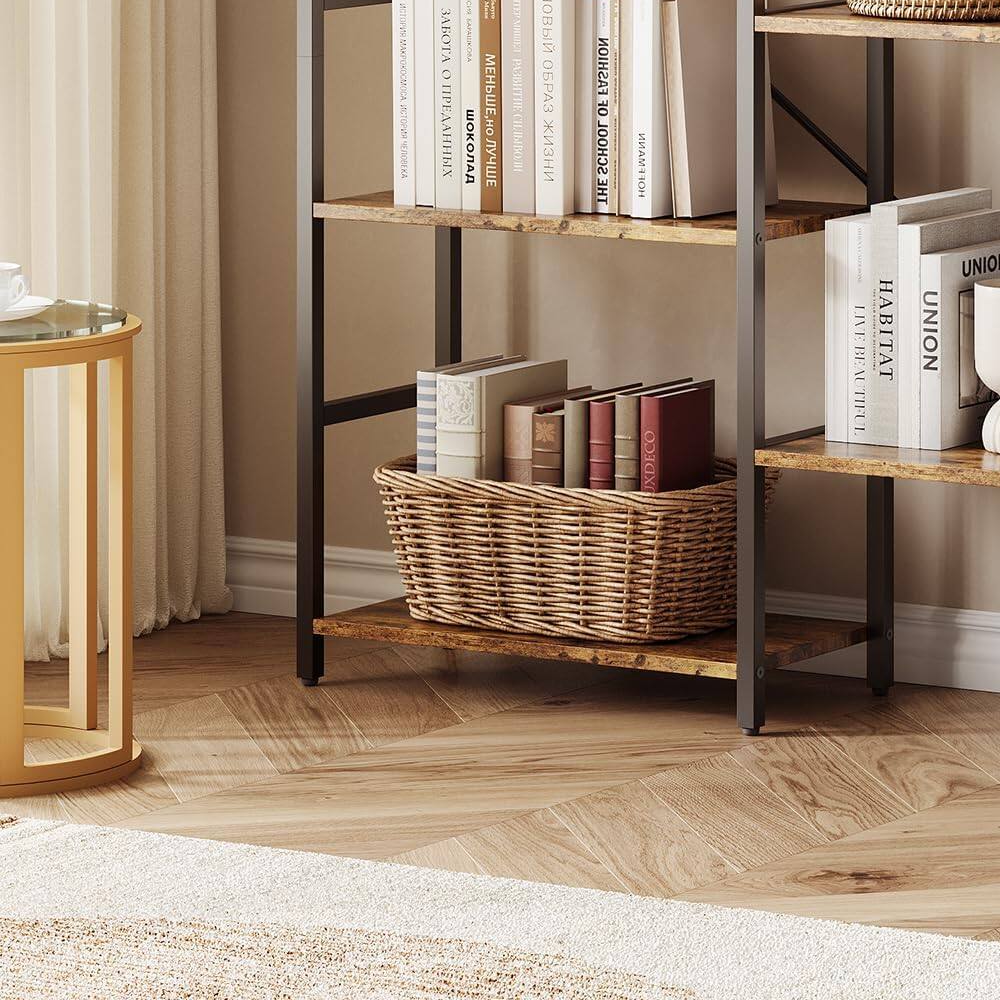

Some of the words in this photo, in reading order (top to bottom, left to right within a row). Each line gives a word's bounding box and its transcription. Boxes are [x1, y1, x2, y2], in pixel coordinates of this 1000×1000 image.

[441, 8, 452, 63] ЗАБОТА
[441, 69, 451, 80] О
[542, 60, 554, 113] ОБРАЗ
[441, 84, 453, 177] ПРЕДАННЫХ
[465, 109, 475, 184] ШОКОЛАД
[542, 119, 555, 183] ЖИЗНИ
[484, 138, 497, 187] ЛУЧШЕ
[854, 305, 865, 342] LIVE
[879, 279, 894, 381] HABITAT
[922, 290, 939, 372] UNION
[853, 346, 866, 436] BEAUTIFUL
[644, 430, 656, 492] UXDECO
